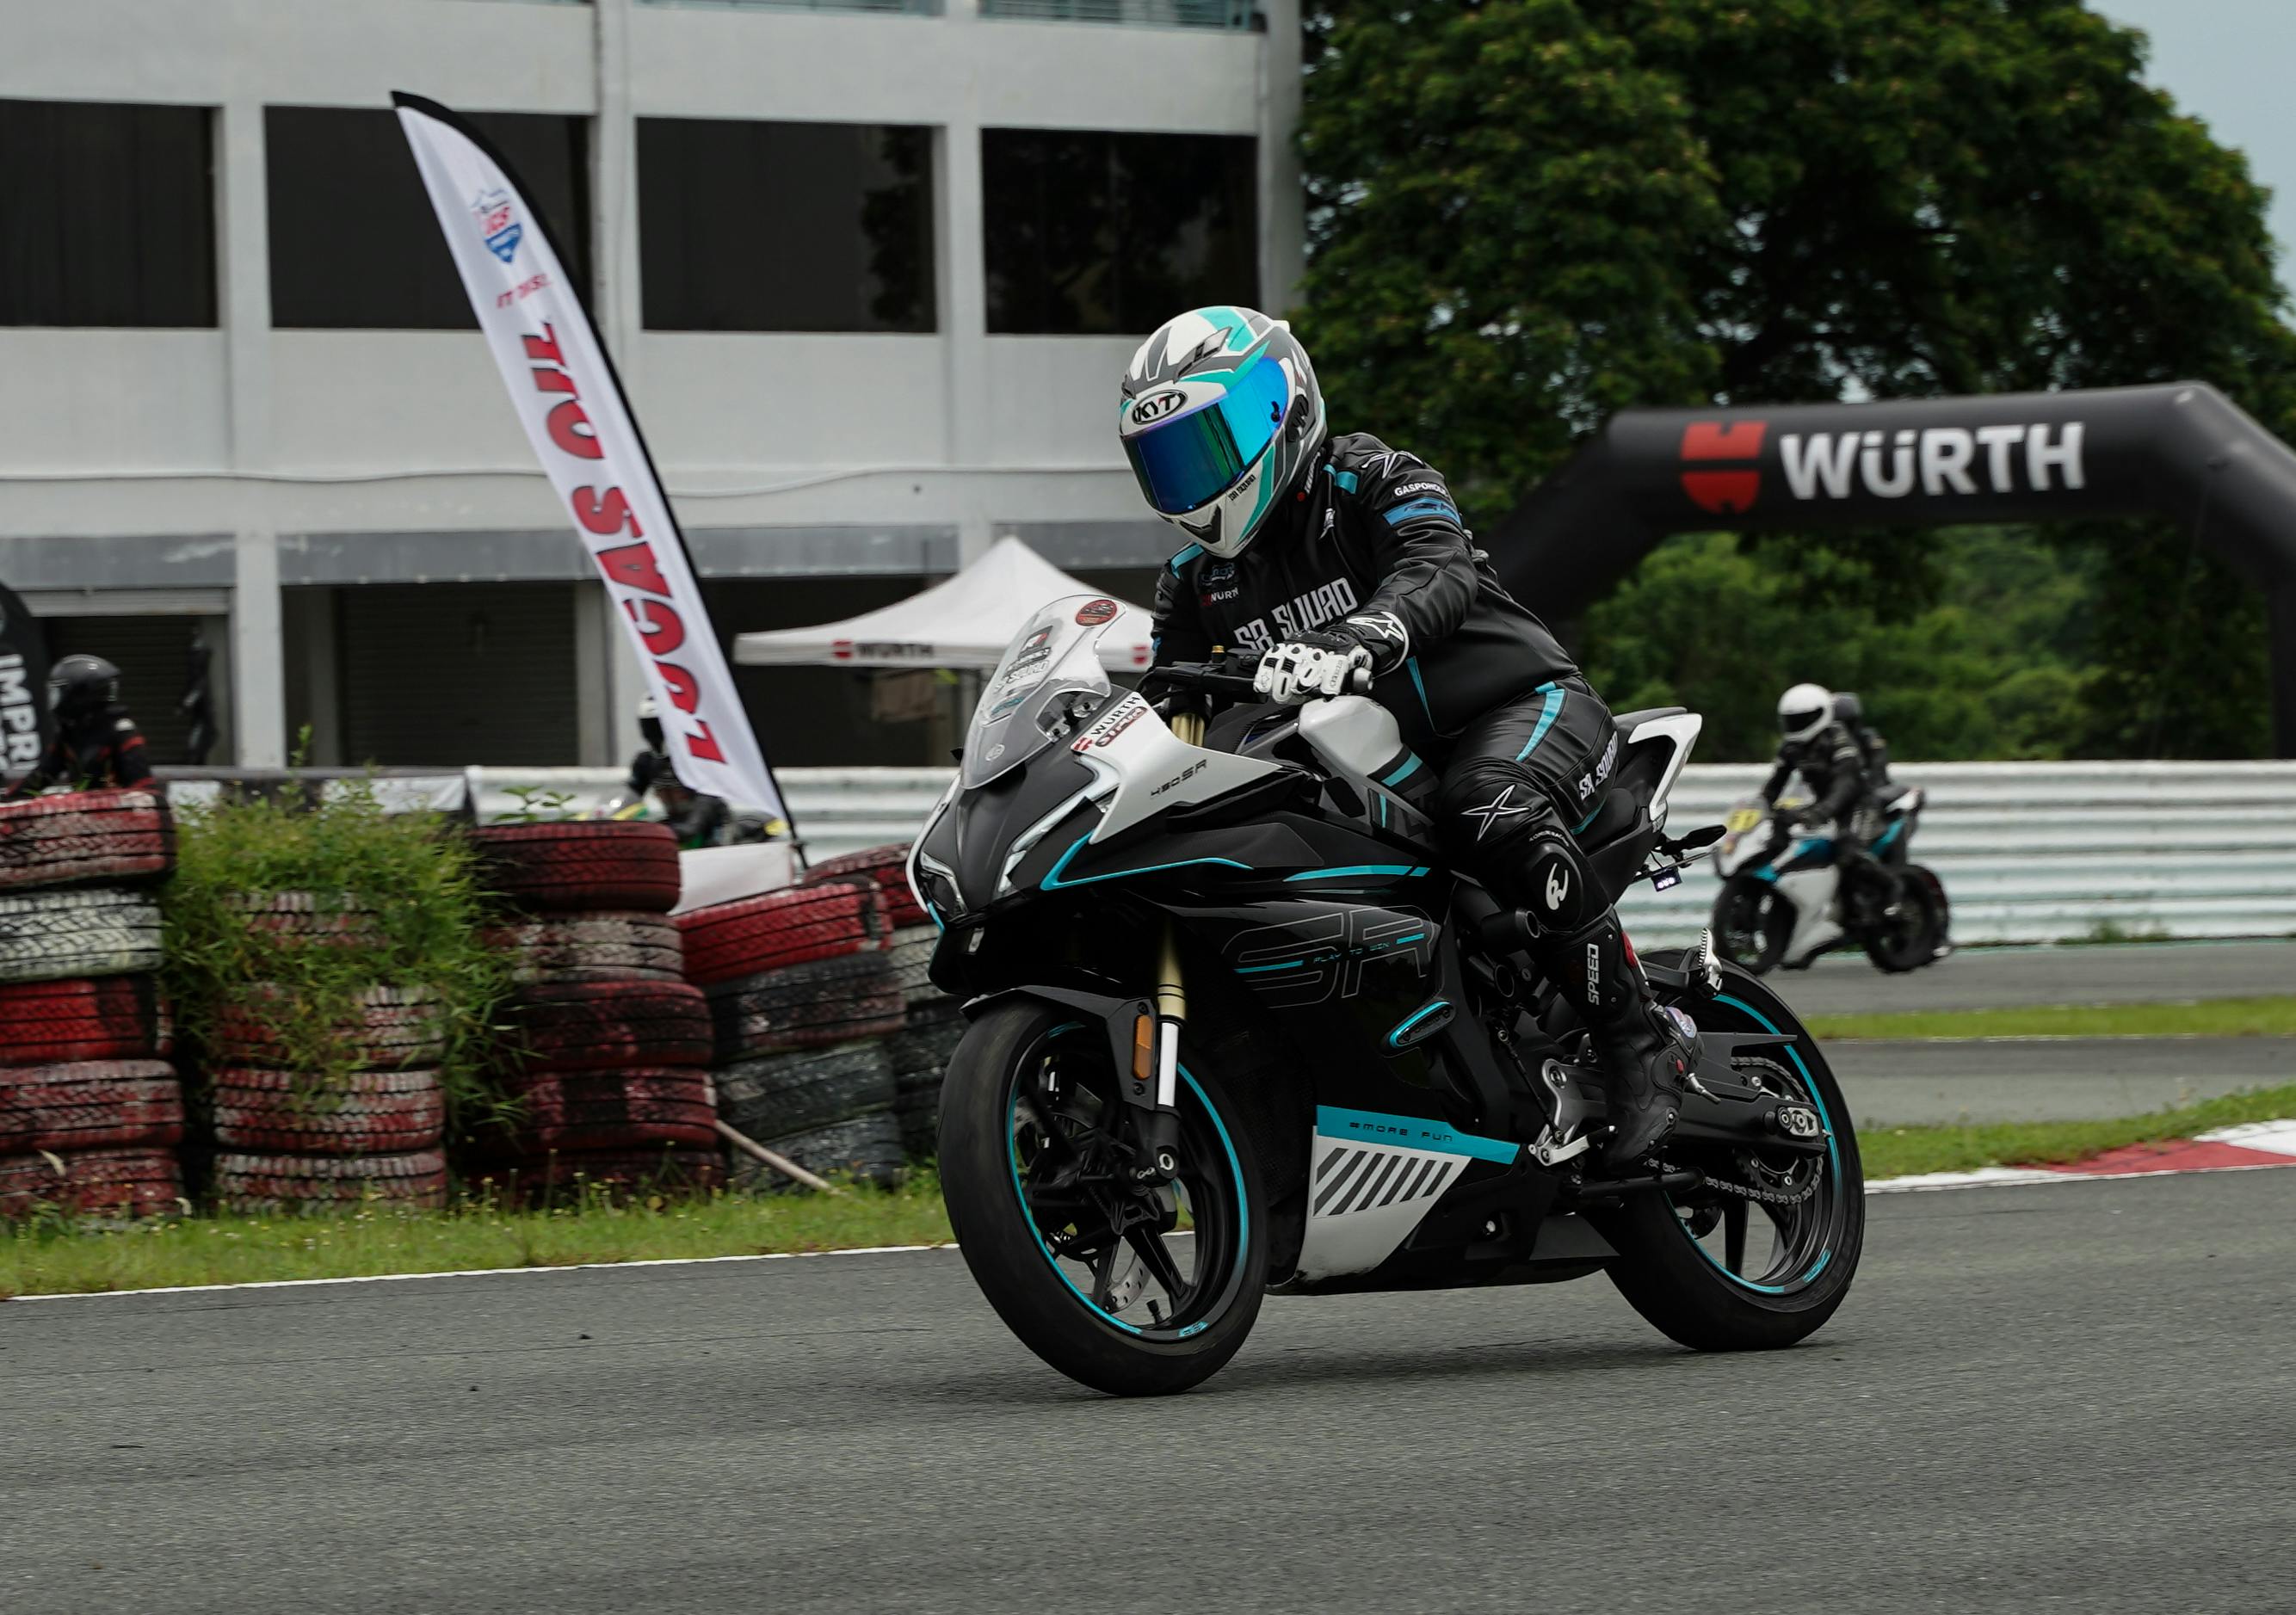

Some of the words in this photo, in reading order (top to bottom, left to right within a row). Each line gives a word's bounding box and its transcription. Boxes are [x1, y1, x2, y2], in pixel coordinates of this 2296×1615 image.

[522, 318, 606, 459] OIL
[1137, 392, 1178, 422] KYT
[1779, 421, 2086, 500] WÜRTH
[571, 484, 728, 764] LUCAS
[1587, 943, 1600, 1006] SPEED
